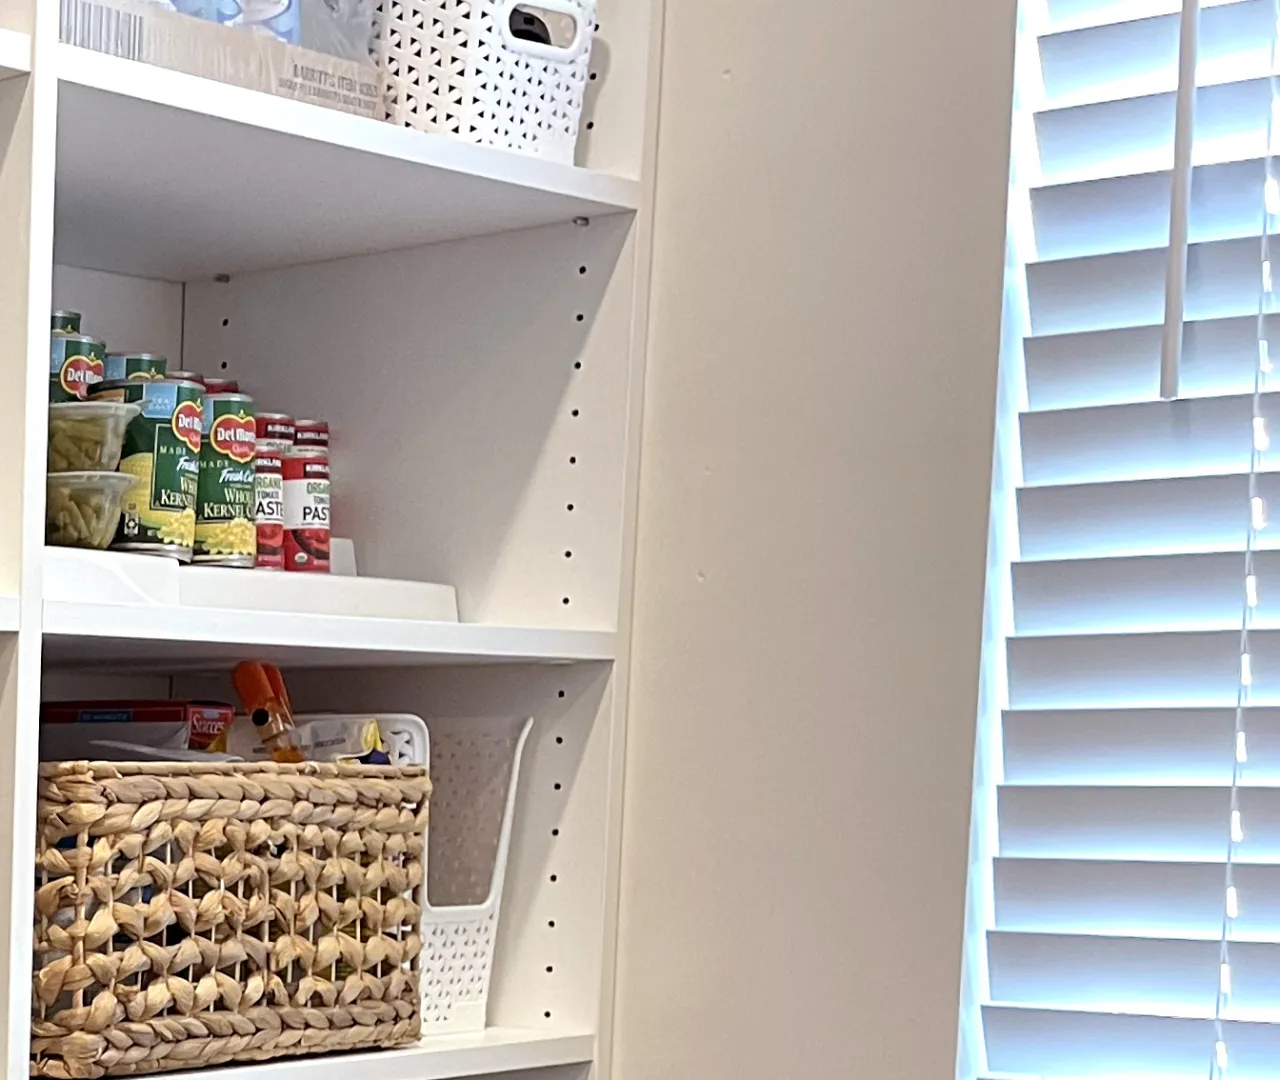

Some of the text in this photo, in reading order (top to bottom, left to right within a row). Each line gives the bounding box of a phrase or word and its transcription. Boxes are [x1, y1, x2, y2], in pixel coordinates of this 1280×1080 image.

[66, 367, 85, 382] Del
[178, 413, 193, 428] Del
[216, 427, 235, 442] Del
[256, 501, 284, 516] ASTE
